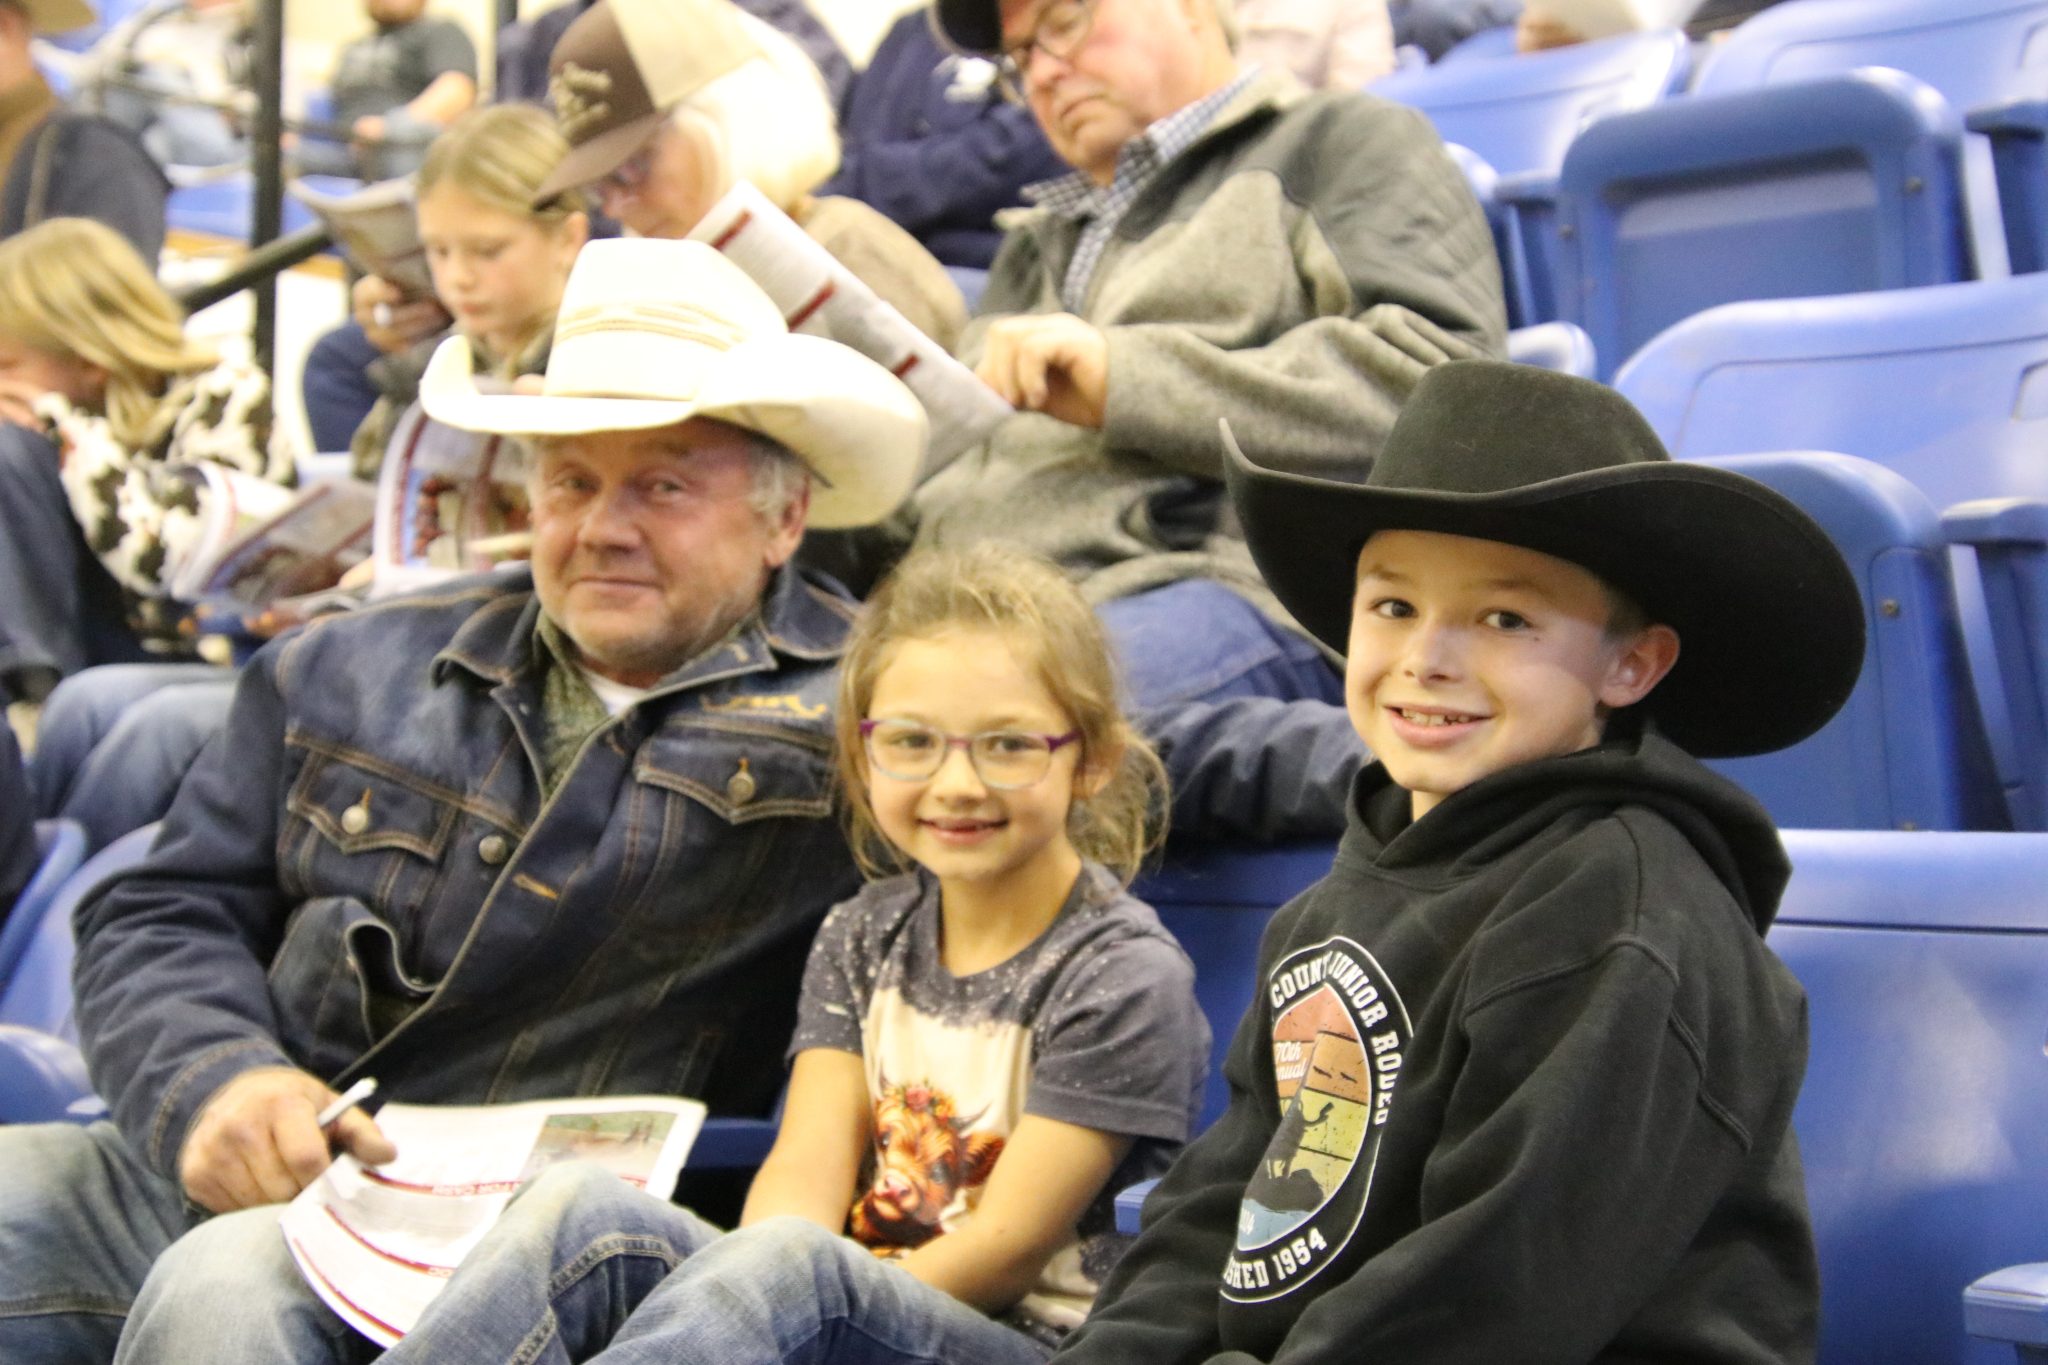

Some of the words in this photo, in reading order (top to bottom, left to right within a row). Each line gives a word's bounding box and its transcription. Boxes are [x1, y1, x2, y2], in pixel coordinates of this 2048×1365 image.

[1270, 950, 1334, 1009] COUNT
[1327, 951, 1389, 1028] JUNIOR
[1370, 1030, 1403, 1126] RODEO
[1271, 1227, 1328, 1281] 1954
